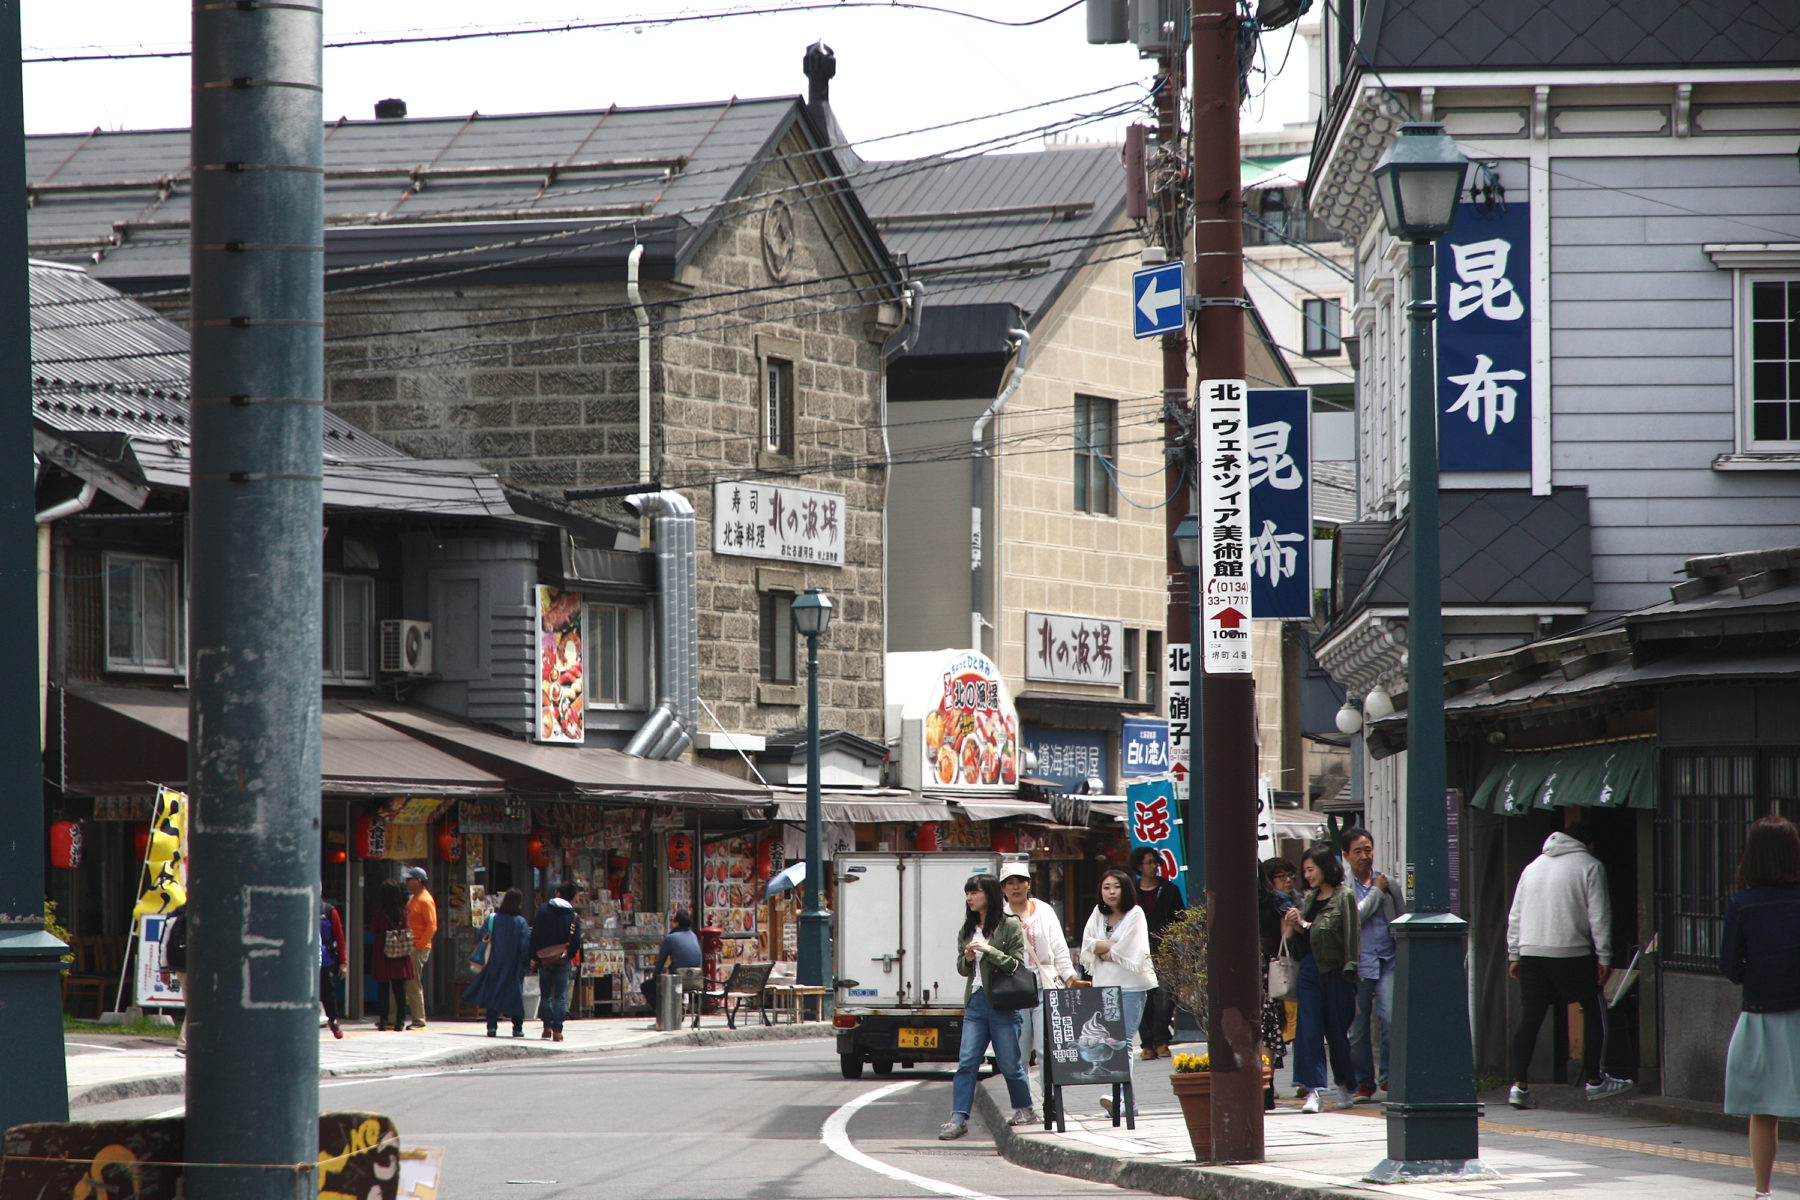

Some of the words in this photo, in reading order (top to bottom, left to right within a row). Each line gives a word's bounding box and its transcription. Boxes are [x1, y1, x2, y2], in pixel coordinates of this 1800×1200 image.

[1445, 238, 1527, 436] 昆布
[731, 486, 760, 515] 寿司
[1210, 384, 1244, 577] 北一ヴェネツィア美術館
[1248, 420, 1305, 588] 昆布
[723, 520, 766, 549] 北海料理
[768, 487, 839, 546] 北の漁場
[1207, 595, 1249, 605] 33-1717
[1216, 582, 1249, 594] (0134)
[1037, 616, 1113, 678] 北の漁場
[1169, 647, 1191, 746] 北一硝子
[1026, 742, 1100, 778] 樽海鮮問屋
[1127, 738, 1169, 767] 白い恋人
